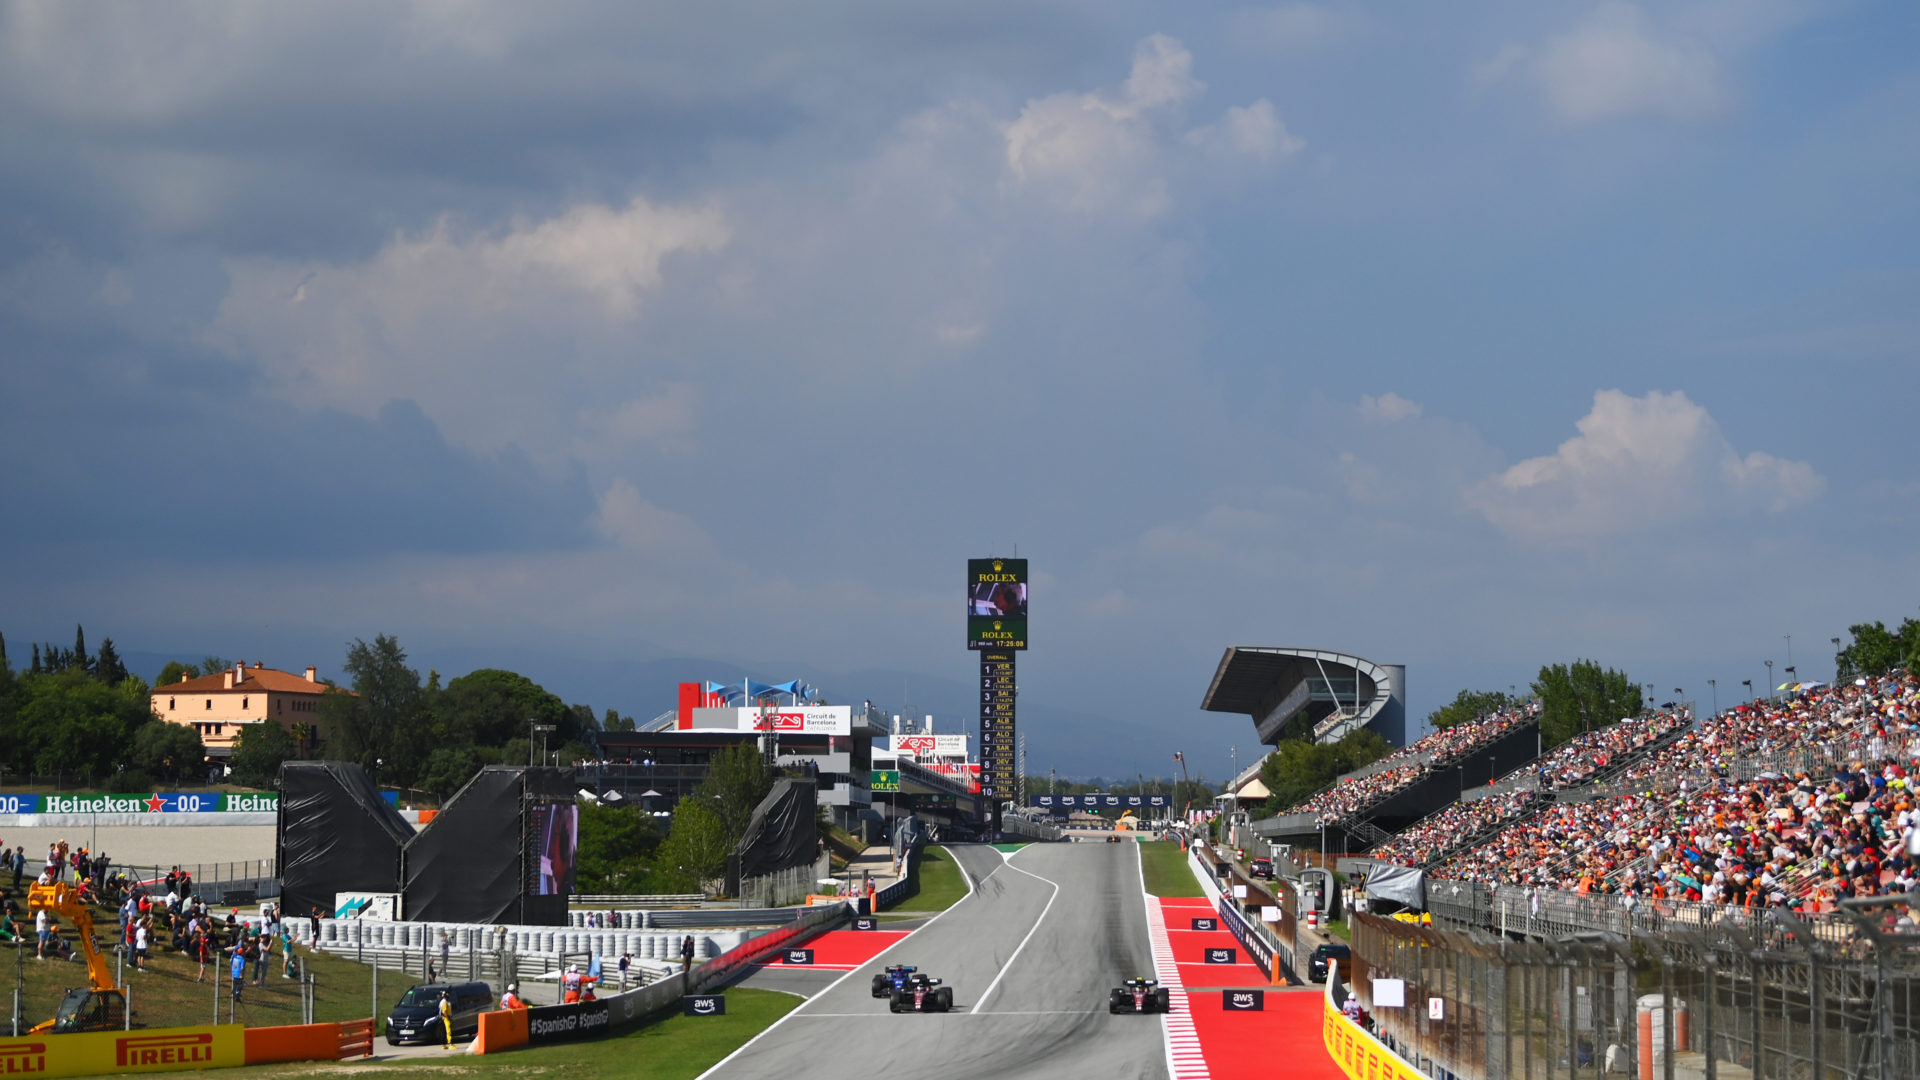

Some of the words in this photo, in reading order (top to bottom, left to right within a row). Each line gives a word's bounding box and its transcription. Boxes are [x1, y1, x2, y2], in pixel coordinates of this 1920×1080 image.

[979, 573, 1016, 582] ROLEX
[982, 631, 1013, 639] ROLEX
[985, 665, 990, 674] 1
[984, 679, 990, 687] 2
[984, 692, 990, 701] 3
[984, 706, 990, 714] 4
[984, 719, 990, 728] 5
[984, 733, 990, 742] 6
[984, 747, 990, 755] 7
[984, 760, 990, 769] 8
[984, 774, 990, 783] 9
[982, 788, 992, 796] 10
[45, 795, 141, 813] Heineken
[177, 795, 200, 812] 0.0
[790, 951, 807, 960] aws
[1212, 950, 1228, 959] aws
[1233, 993, 1254, 1002] aws
[694, 998, 715, 1008] aws
[530, 1015, 576, 1036] #SpanishGP
[115, 1033, 214, 1067] PIRELLI
